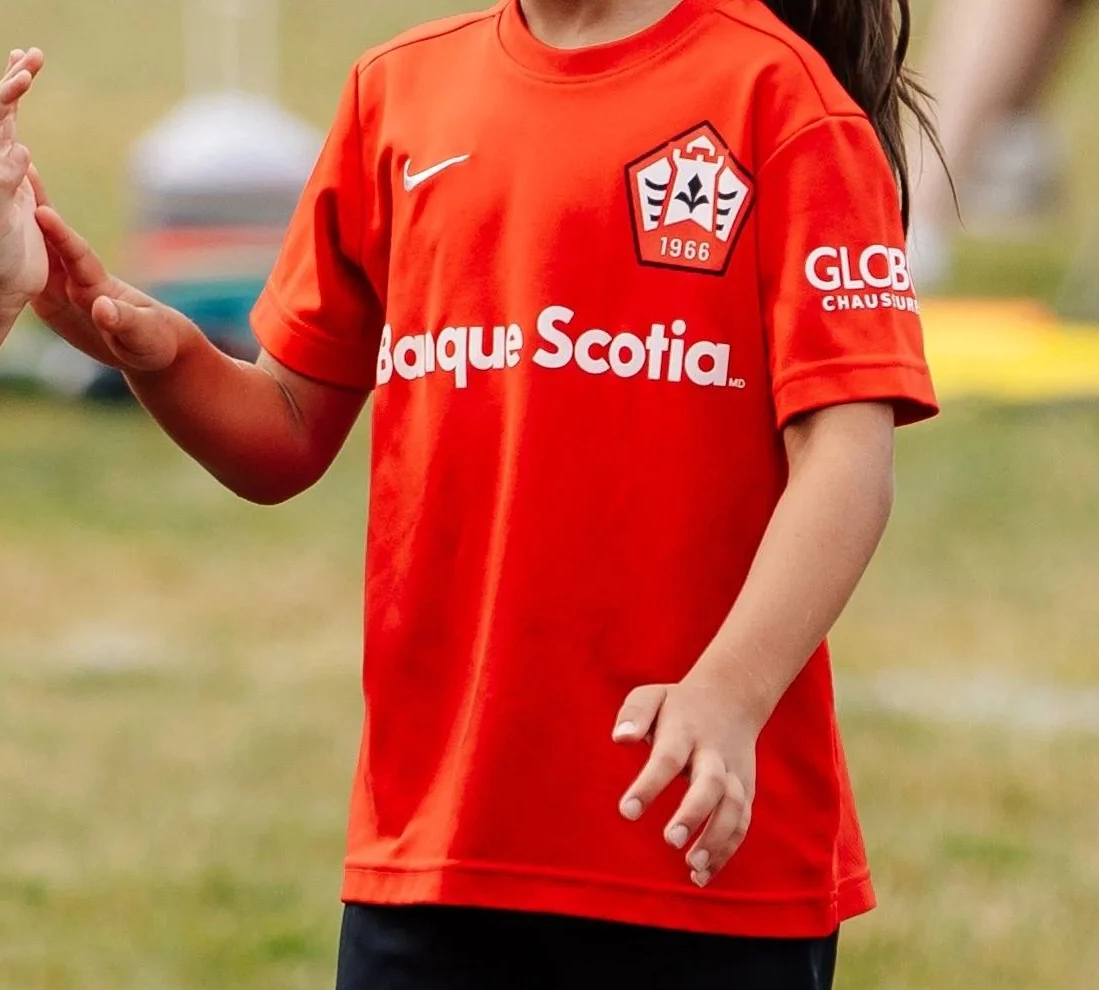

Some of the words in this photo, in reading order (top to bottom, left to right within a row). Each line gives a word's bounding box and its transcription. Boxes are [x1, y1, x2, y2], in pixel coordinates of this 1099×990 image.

[660, 236, 710, 261] 1966
[805, 244, 915, 291] GLOB
[822, 292, 920, 315] CHAUSUR
[532, 305, 730, 387] Scotia
